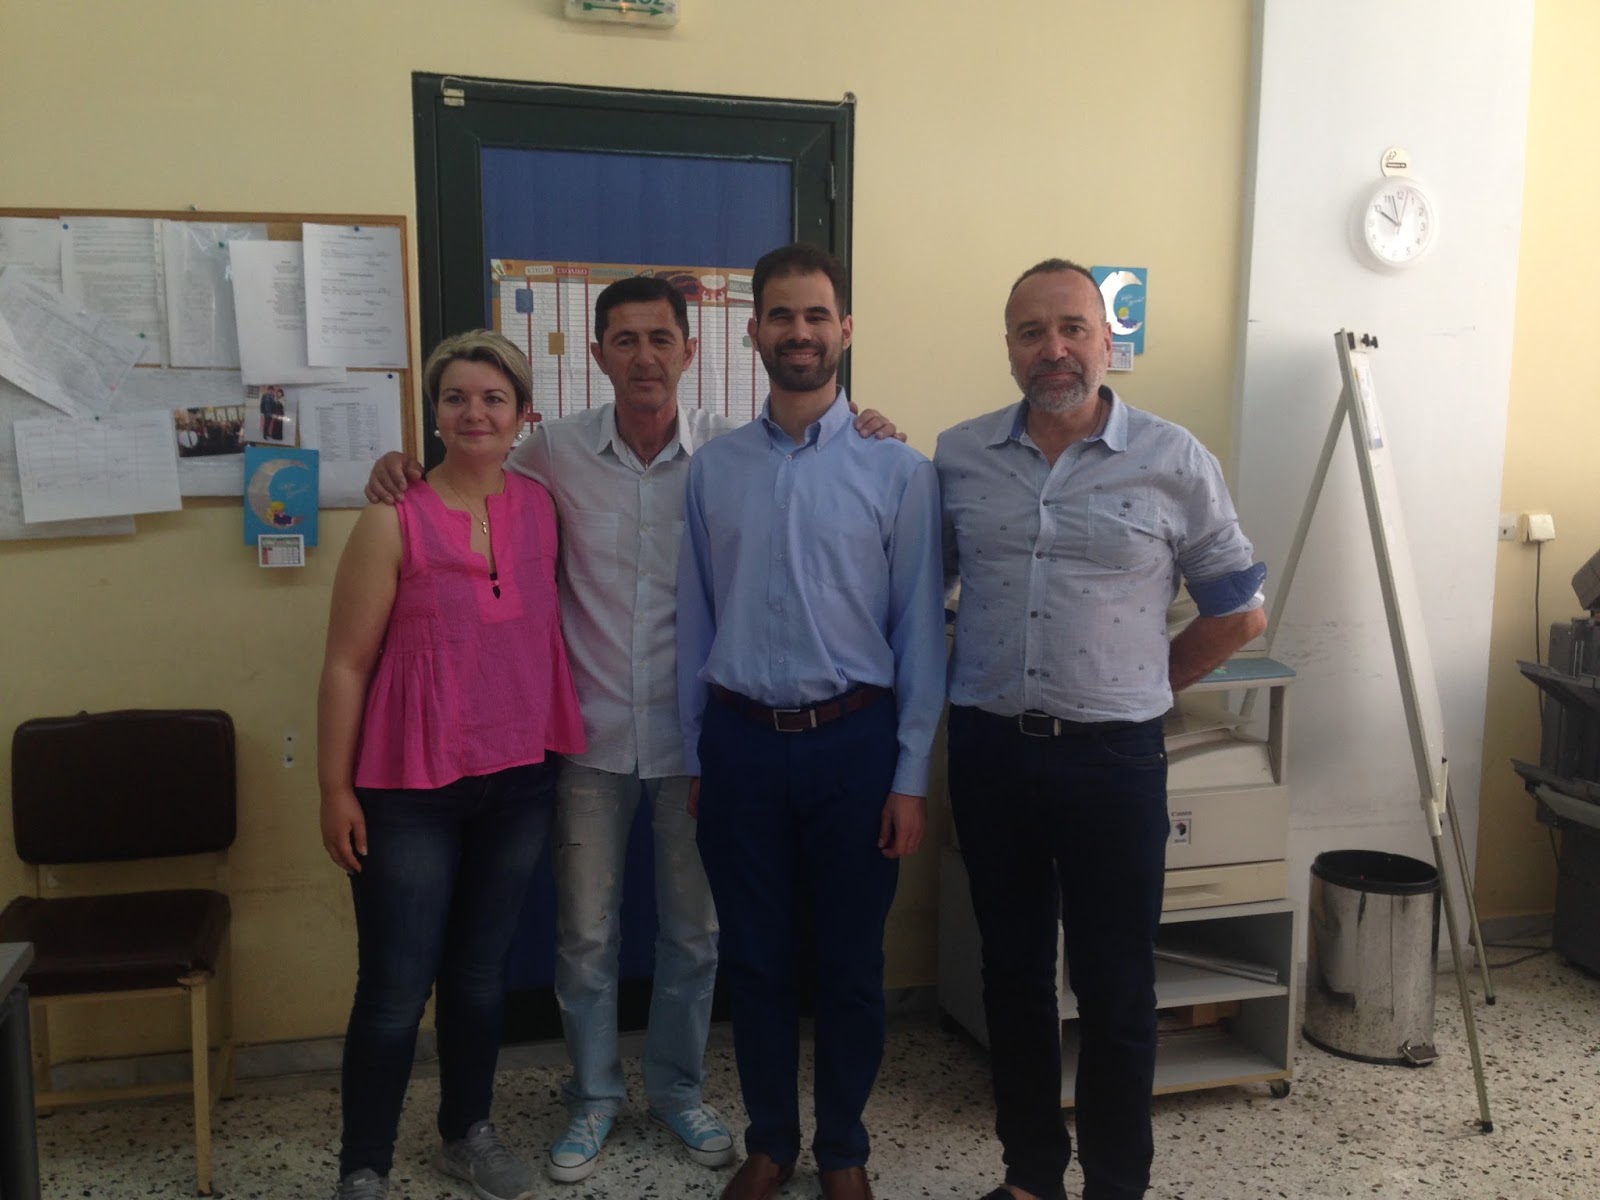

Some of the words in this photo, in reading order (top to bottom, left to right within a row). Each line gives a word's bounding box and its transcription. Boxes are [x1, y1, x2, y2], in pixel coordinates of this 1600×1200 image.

[1384, 195, 1391, 203] 11
[1397, 191, 1404, 200] 12
[1419, 207, 1424, 216] 2
[1420, 222, 1426, 231] 3
